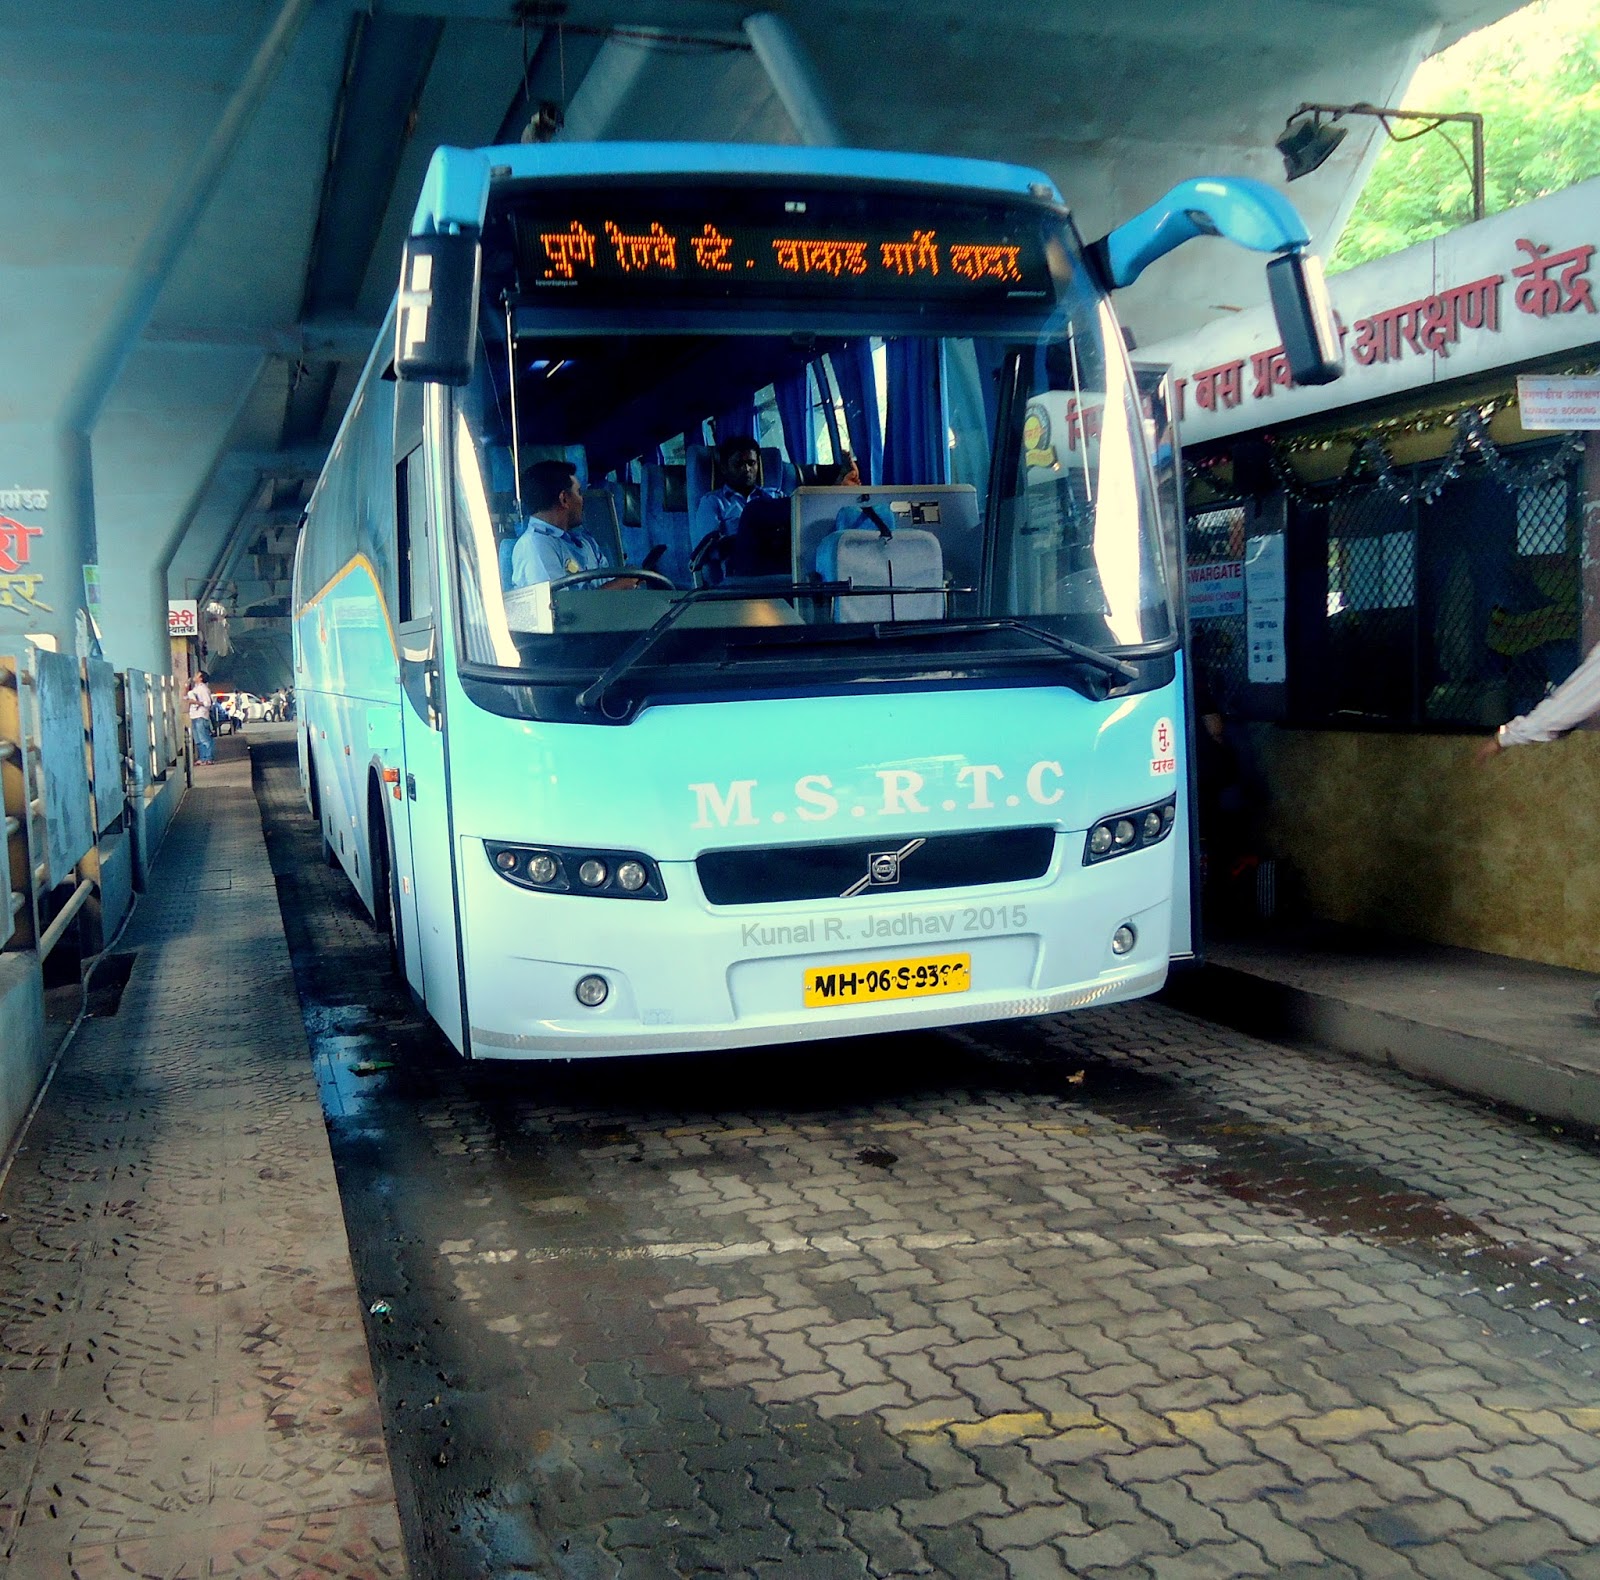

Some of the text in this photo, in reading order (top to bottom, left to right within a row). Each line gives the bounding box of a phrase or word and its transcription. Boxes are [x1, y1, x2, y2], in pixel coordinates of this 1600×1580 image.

[1193, 359, 1243, 411] बस
[1351, 274, 1503, 365] आरक्षण
[1512, 238, 1596, 317] केंद्र
